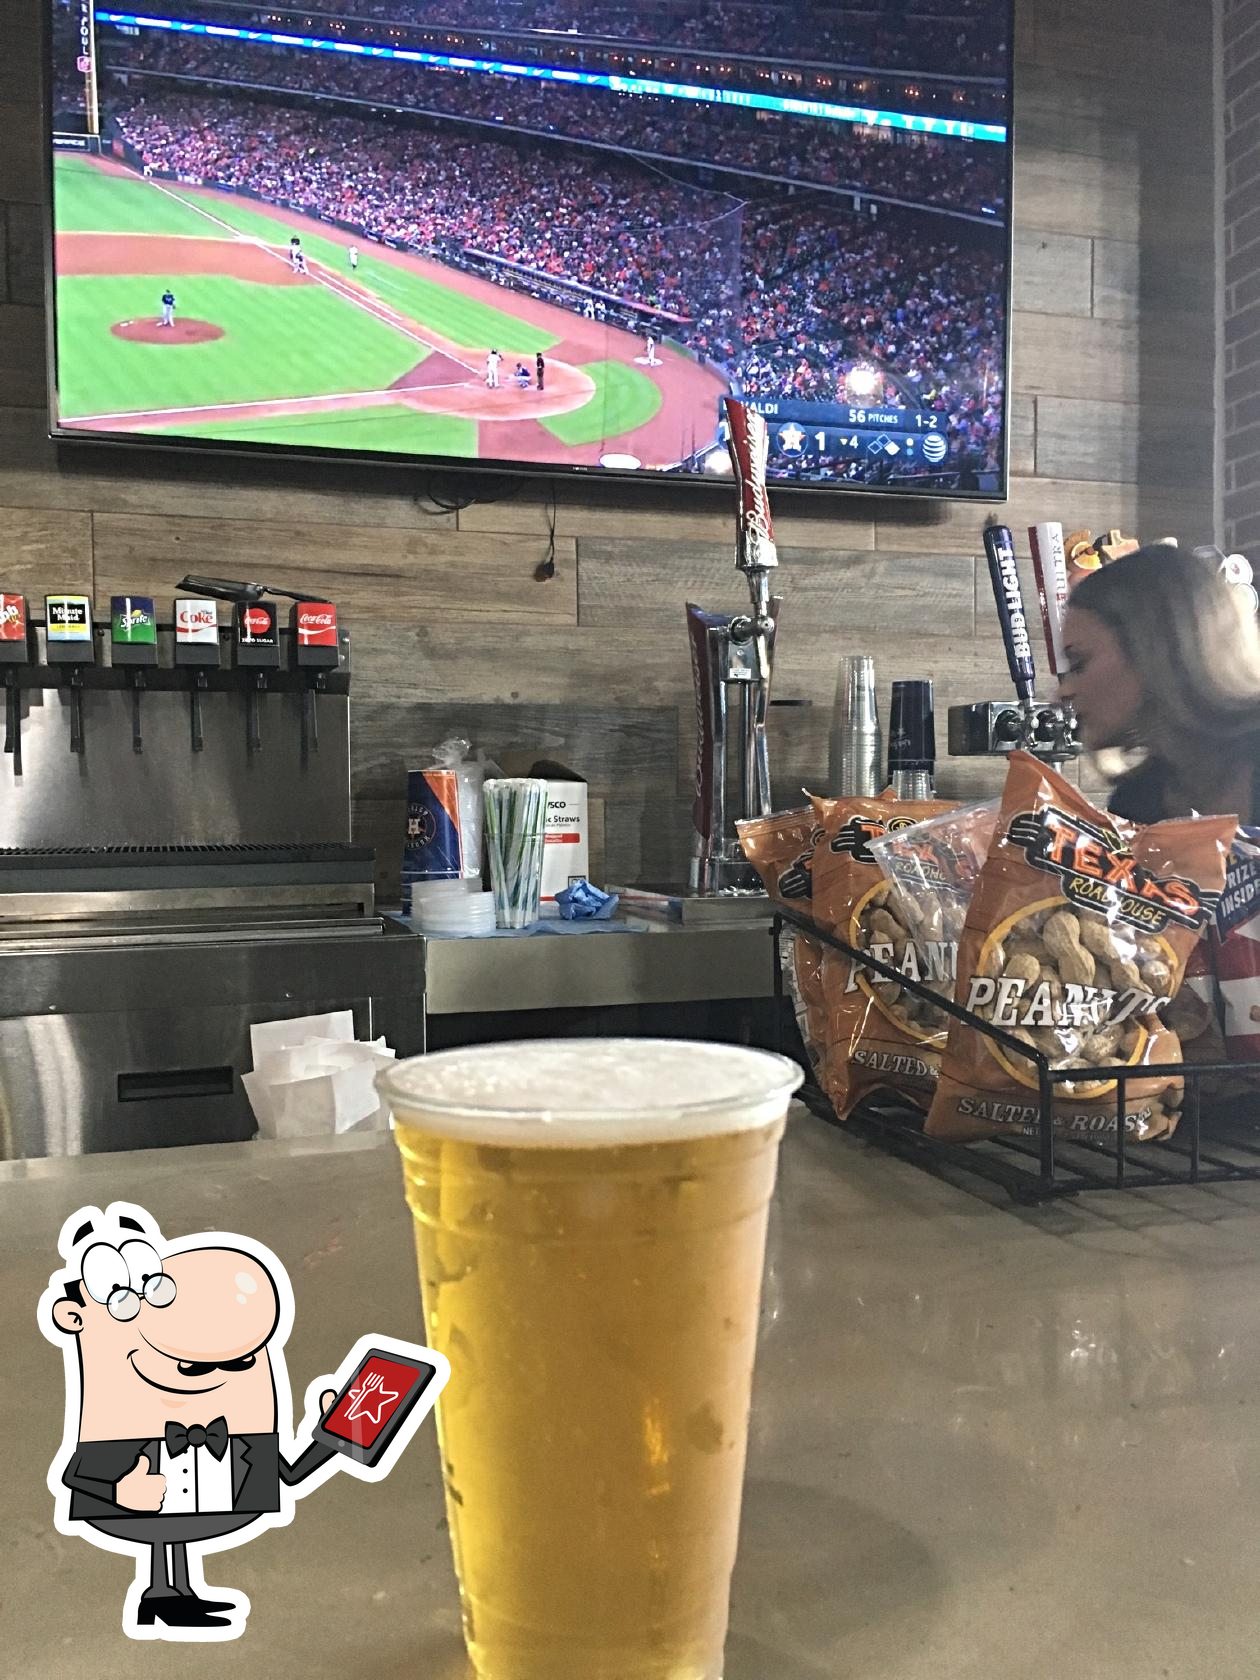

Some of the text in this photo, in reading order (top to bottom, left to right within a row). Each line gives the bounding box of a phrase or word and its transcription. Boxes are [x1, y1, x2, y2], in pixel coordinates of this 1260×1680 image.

[849, 409, 866, 423] 56
[868, 413, 898, 424] PITCHES
[915, 414, 938, 429] 1-2
[814, 432, 859, 451] 1 4
[998, 548, 1032, 658] BUD LIGHT
[121, 614, 148, 629] Sprite
[180, 610, 213, 623] Coke
[553, 815, 580, 823] Straws
[1226, 860, 1258, 889] RIZE
[853, 1050, 928, 1077] SALTED
